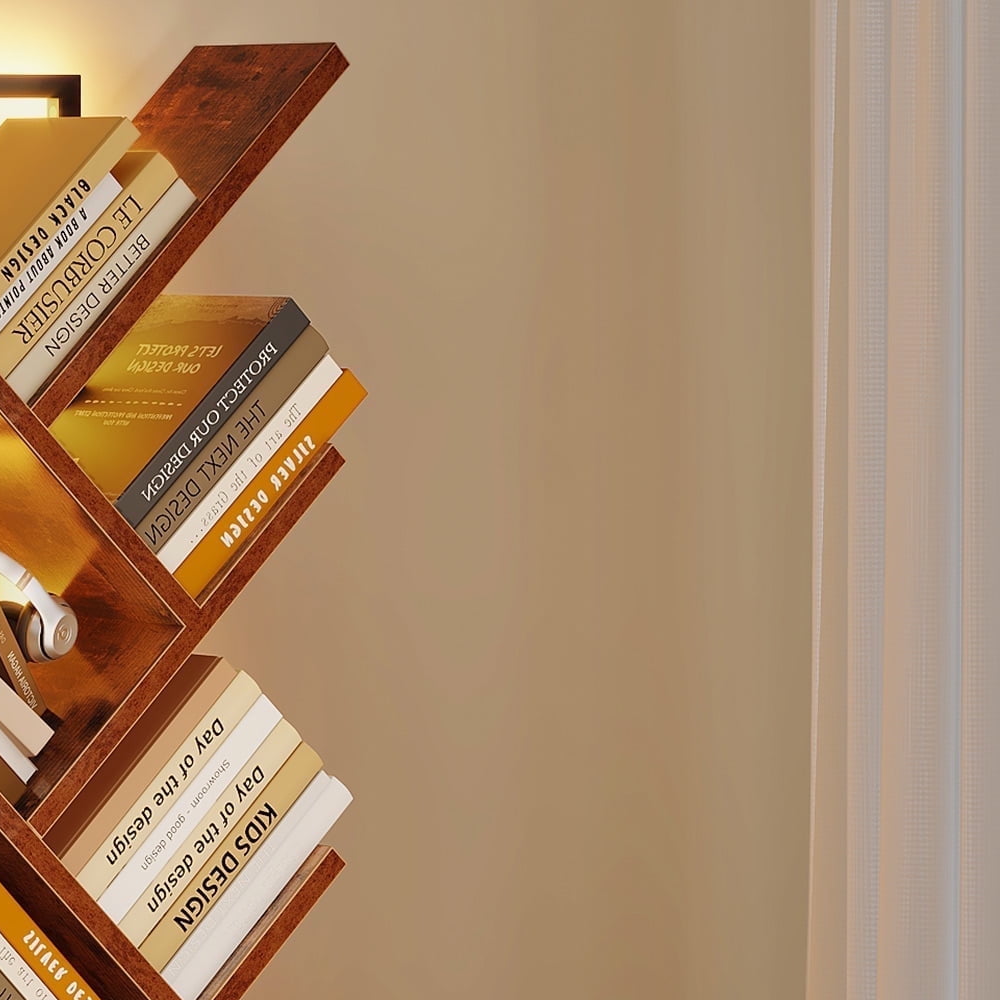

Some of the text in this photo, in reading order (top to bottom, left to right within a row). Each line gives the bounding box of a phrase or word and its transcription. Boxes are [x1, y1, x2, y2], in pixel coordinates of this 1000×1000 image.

[0, 178, 91, 282] BLACK DESIGN
[54, 217, 79, 250] BOOK
[78, 207, 87, 220] A
[11, 194, 143, 344] LE CORBUSIER
[26, 245, 54, 283] ABOUT
[44, 233, 150, 357] BETTER DESIGN
[106, 717, 224, 865] Day of the design
[190, 759, 230, 808] Showroom
[141, 839, 167, 870] design
[147, 765, 264, 912] Day of the design
[165, 813, 186, 841] good
[173, 802, 278, 933] KIDS DESIGN
